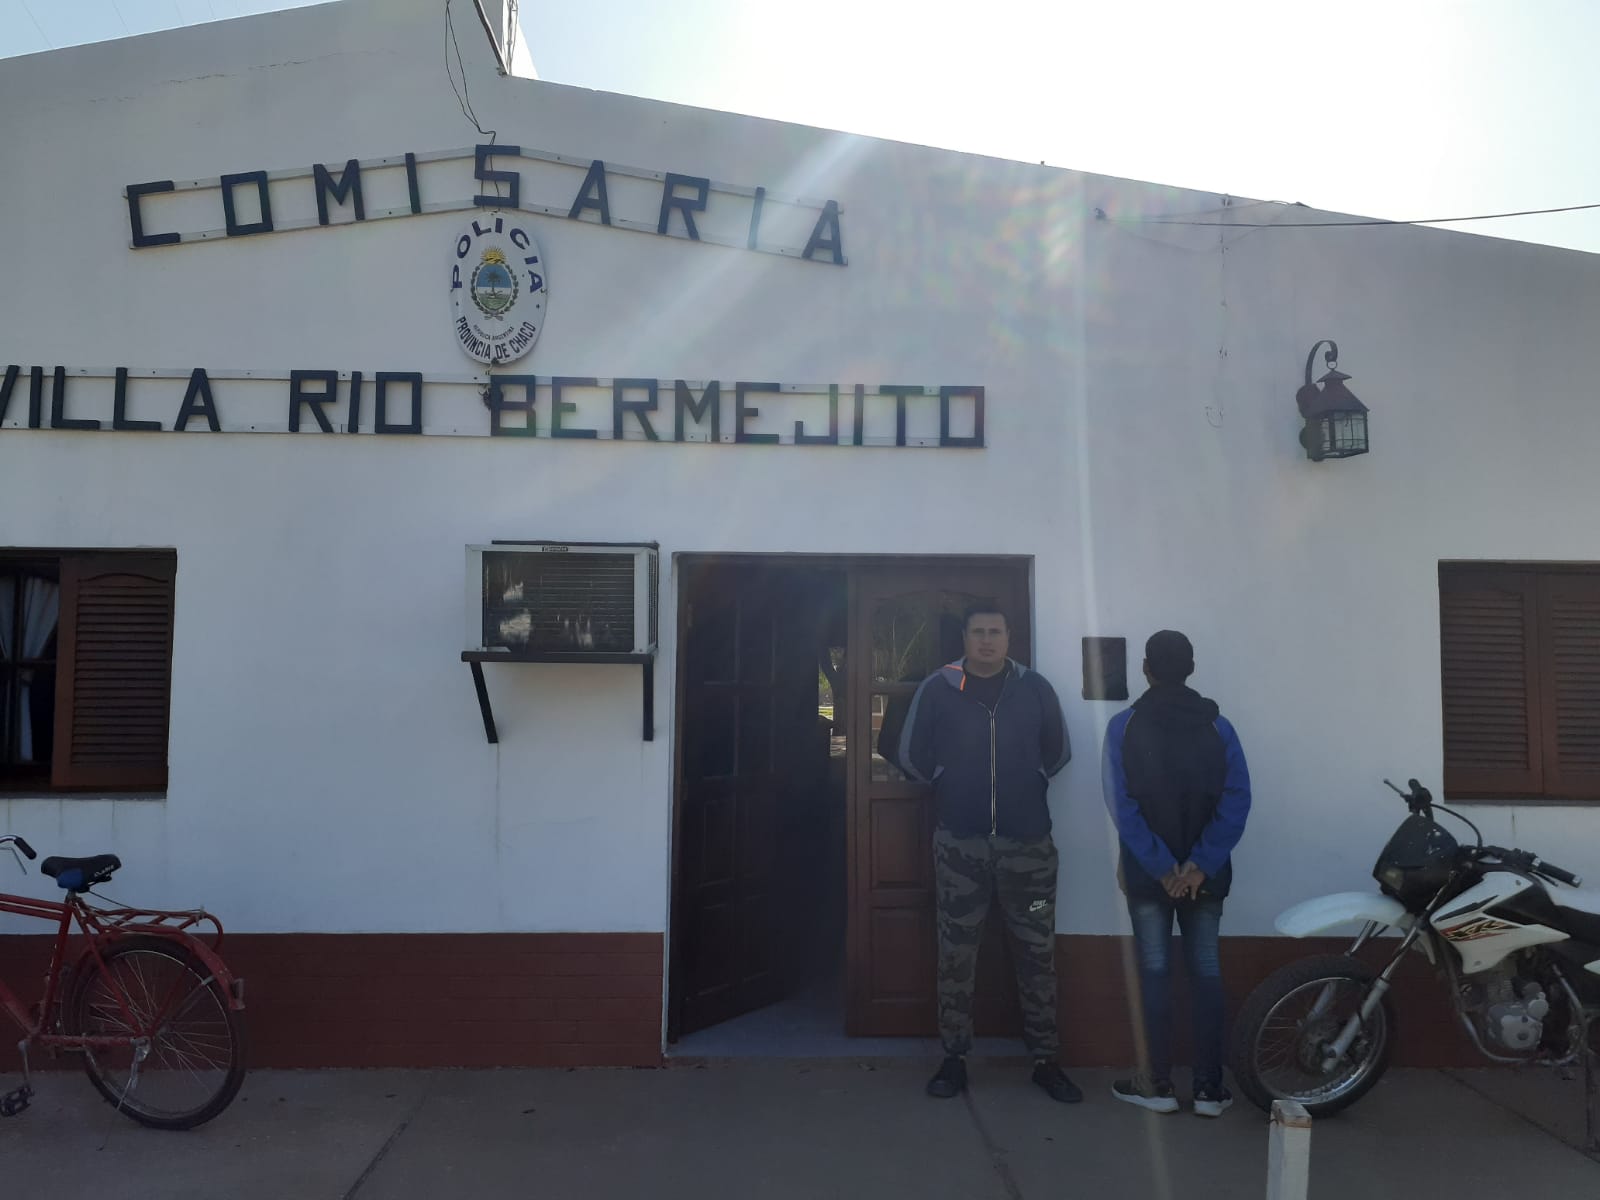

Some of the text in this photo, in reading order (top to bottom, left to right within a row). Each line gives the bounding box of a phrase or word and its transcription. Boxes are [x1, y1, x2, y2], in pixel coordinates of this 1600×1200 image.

[126, 144, 845, 265] COMISARIA
[451, 217, 544, 294] POLICIA
[455, 315, 537, 360] PROVINCIA DE CHACO
[288, 369, 423, 435] RIO
[490, 374, 985, 449] BERMEJITO
